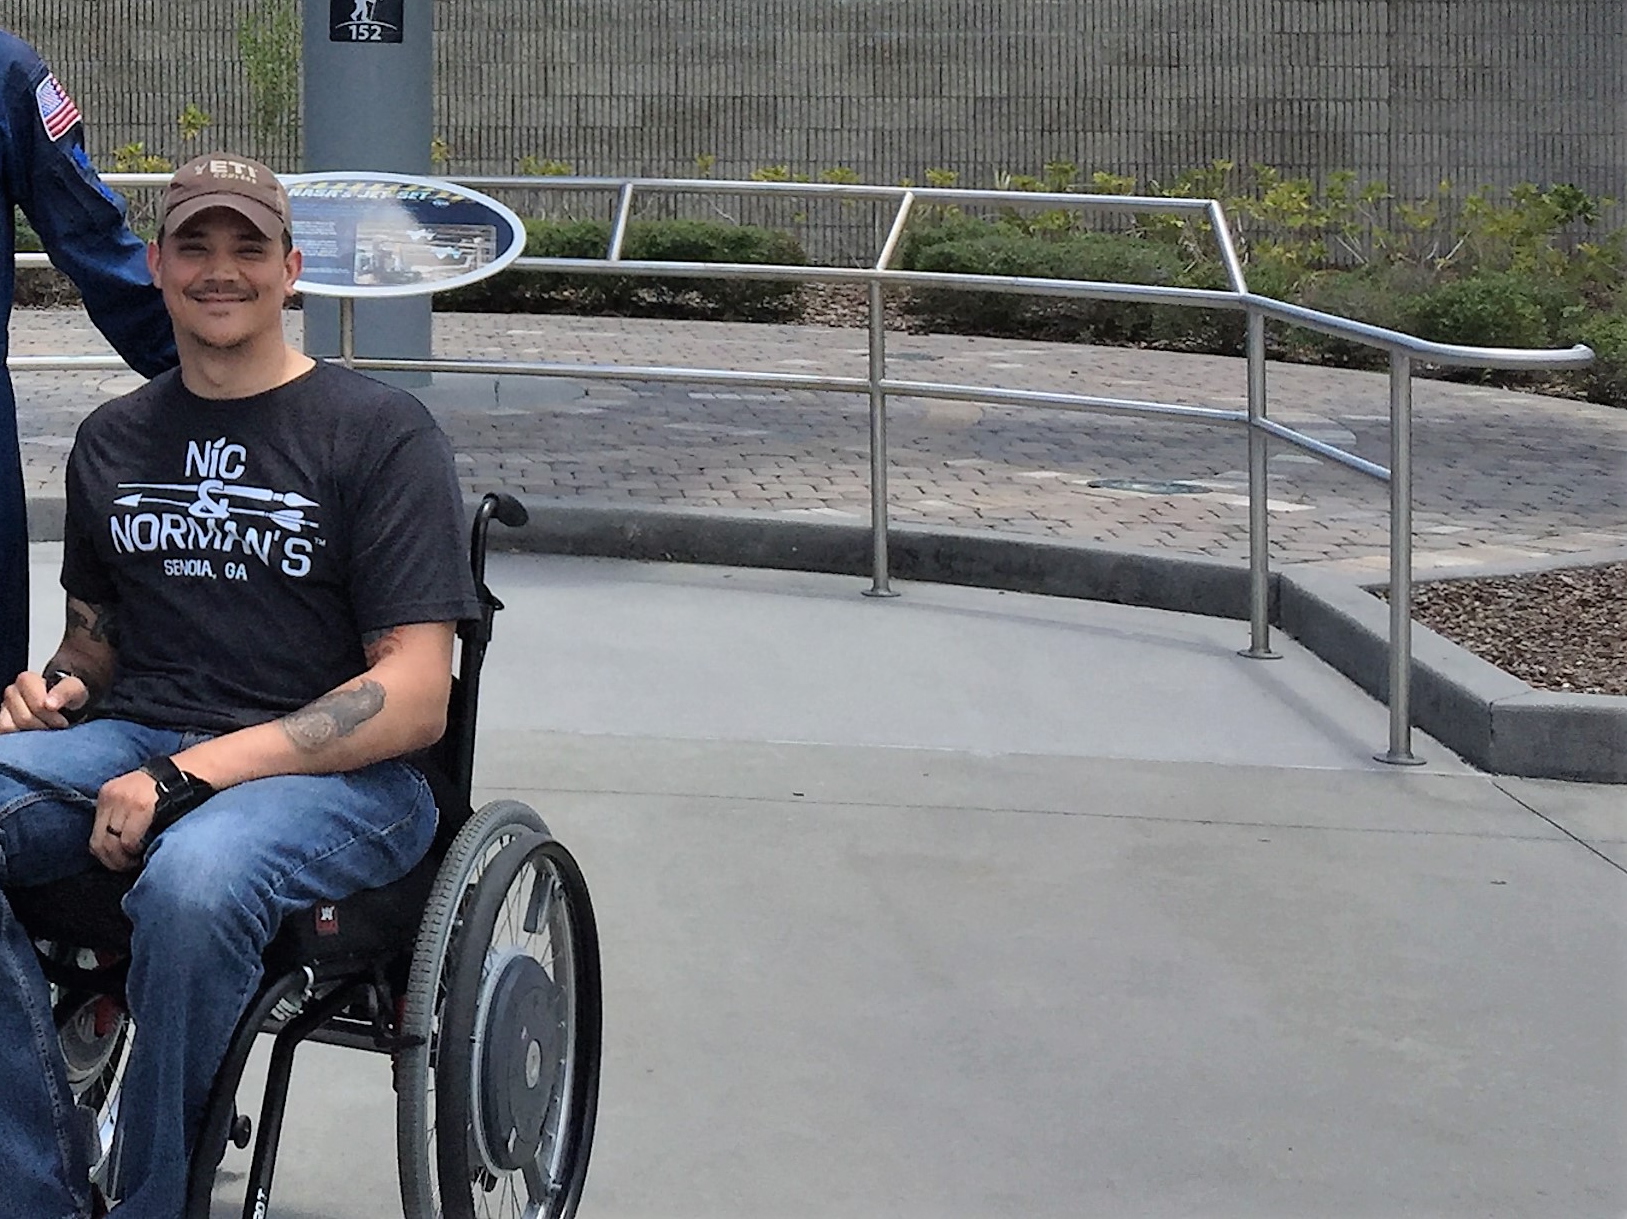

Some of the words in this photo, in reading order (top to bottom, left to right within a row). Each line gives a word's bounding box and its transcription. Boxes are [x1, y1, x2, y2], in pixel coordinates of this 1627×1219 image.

[349, 24, 382, 40] 152
[194, 160, 257, 178] YETI
[395, 191, 431, 200] SET
[187, 479, 230, 519] &
[110, 512, 313, 578] NORMAN'S
[163, 559, 218, 579] SENOIA,
[225, 561, 248, 581] GA
